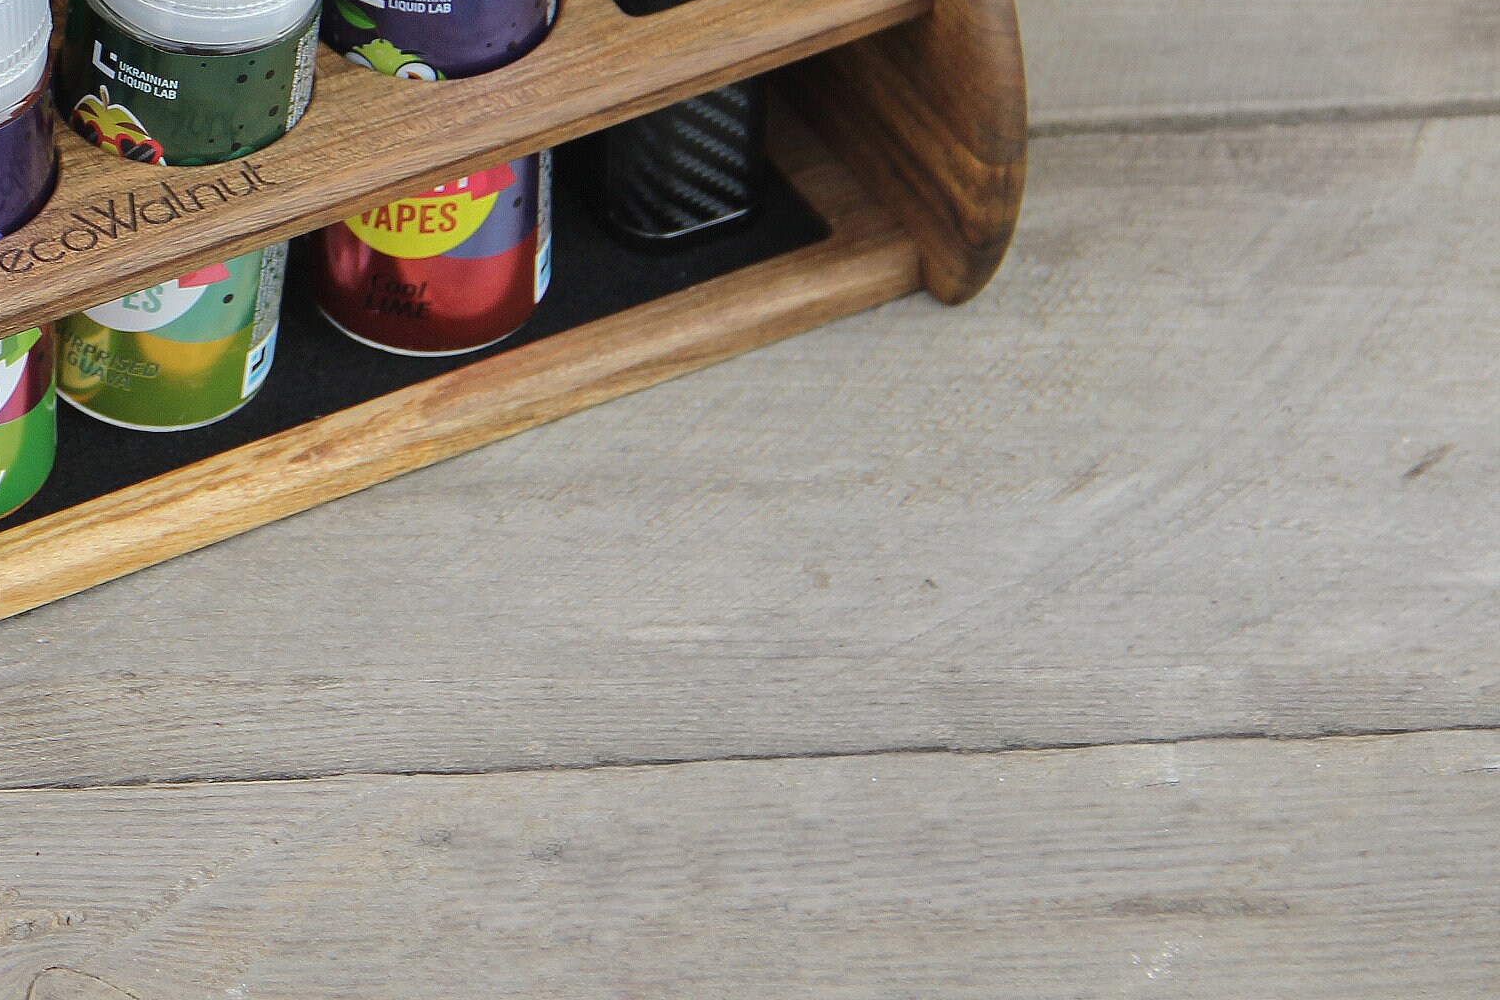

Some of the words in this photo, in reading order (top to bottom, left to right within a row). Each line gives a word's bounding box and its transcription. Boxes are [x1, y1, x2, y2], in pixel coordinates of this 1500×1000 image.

[388, 0, 426, 13] LIQUID
[428, 2, 452, 14] LAB
[118, 71, 152, 93] LIQUID
[154, 86, 177, 101] LAB
[119, 61, 179, 90] UKRAINIAN
